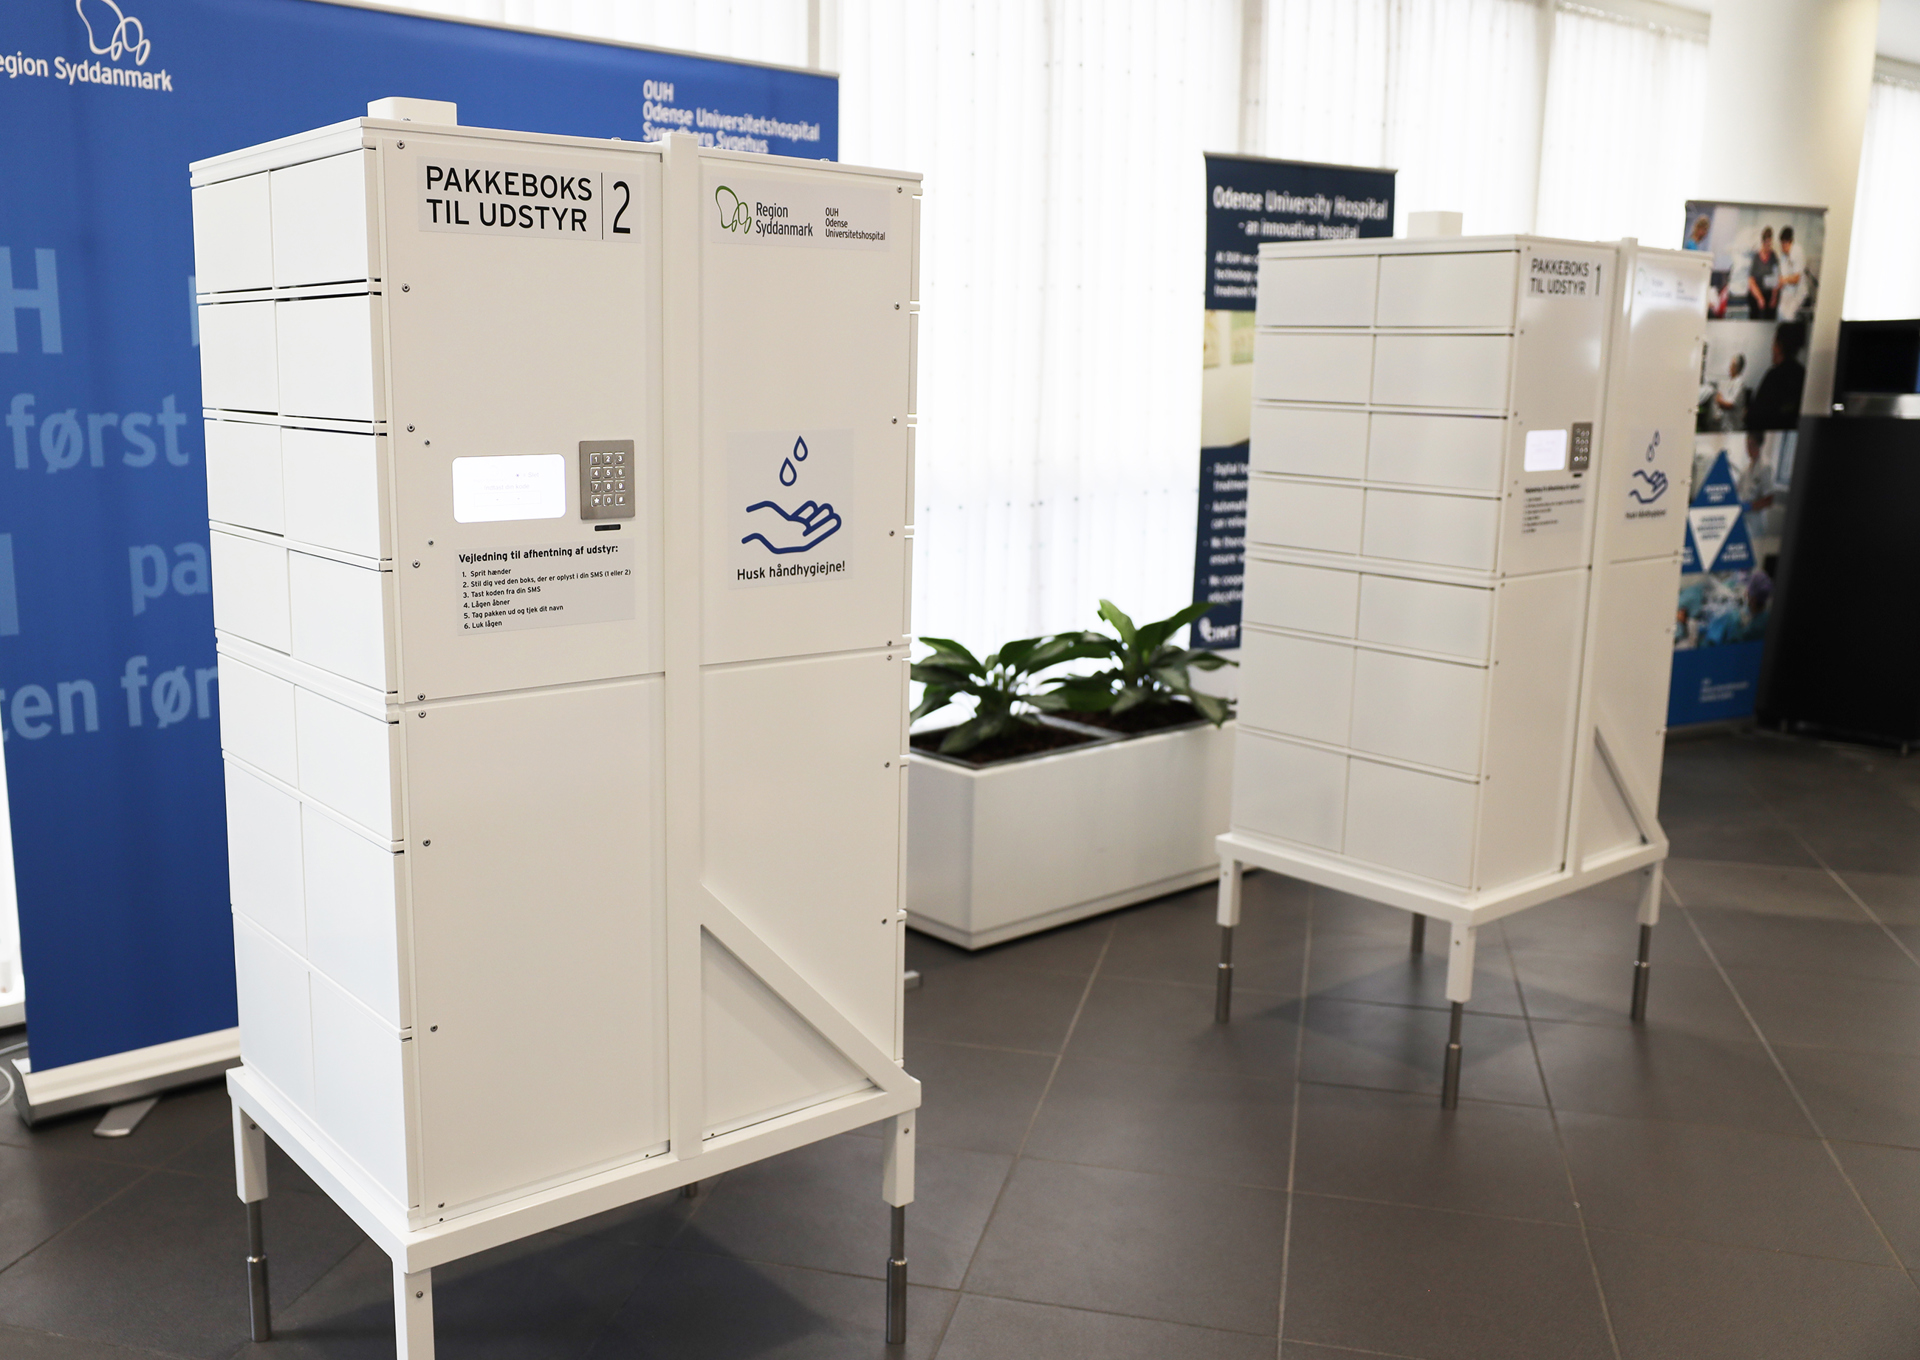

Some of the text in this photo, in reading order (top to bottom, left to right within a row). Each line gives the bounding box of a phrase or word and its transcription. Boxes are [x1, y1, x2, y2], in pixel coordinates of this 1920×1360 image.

[0, 50, 173, 92] gion Syddanmark
[643, 79, 674, 102] OUH
[642, 100, 820, 142] Odense Universitetshospital
[426, 165, 593, 201] PAKKEBOKS
[612, 180, 631, 234] 2
[756, 202, 789, 219] Region
[825, 207, 839, 217] OUH
[1213, 185, 1389, 222] Odense University Hospital
[426, 198, 587, 232] TIL UDSTYR
[825, 217, 848, 228] Odense
[755, 218, 813, 237] Syddanmark
[825, 228, 886, 242] Universitetshospital
[1260, 217, 1317, 239] innovative
[1530, 258, 1590, 277] PAKKEBOKS
[1530, 277, 1587, 295] TIL UDSTYR
[5, 393, 190, 474] først
[458, 544, 619, 564] Vejledning til afhentning af udstyr:
[470, 569, 486, 578] Sprit
[487, 568, 511, 576] hænder
[483, 579, 493, 587] dig
[494, 578, 506, 586] ved
[519, 576, 536, 584] boks,
[556, 573, 575, 581] oplyst
[610, 569, 623, 577] eller
[737, 560, 846, 580] Husk håndhygiejne!
[471, 590, 484, 598] Tast
[486, 588, 505, 597] koden
[516, 587, 526, 595] din
[471, 600, 491, 609] Lågen
[492, 599, 510, 607] åbner
[471, 611, 483, 619] Tag
[484, 610, 507, 619] pakken
[526, 607, 538, 615] tjek
[472, 621, 484, 629] Luk
[484, 620, 503, 628] lågen
[120, 655, 218, 729] før
